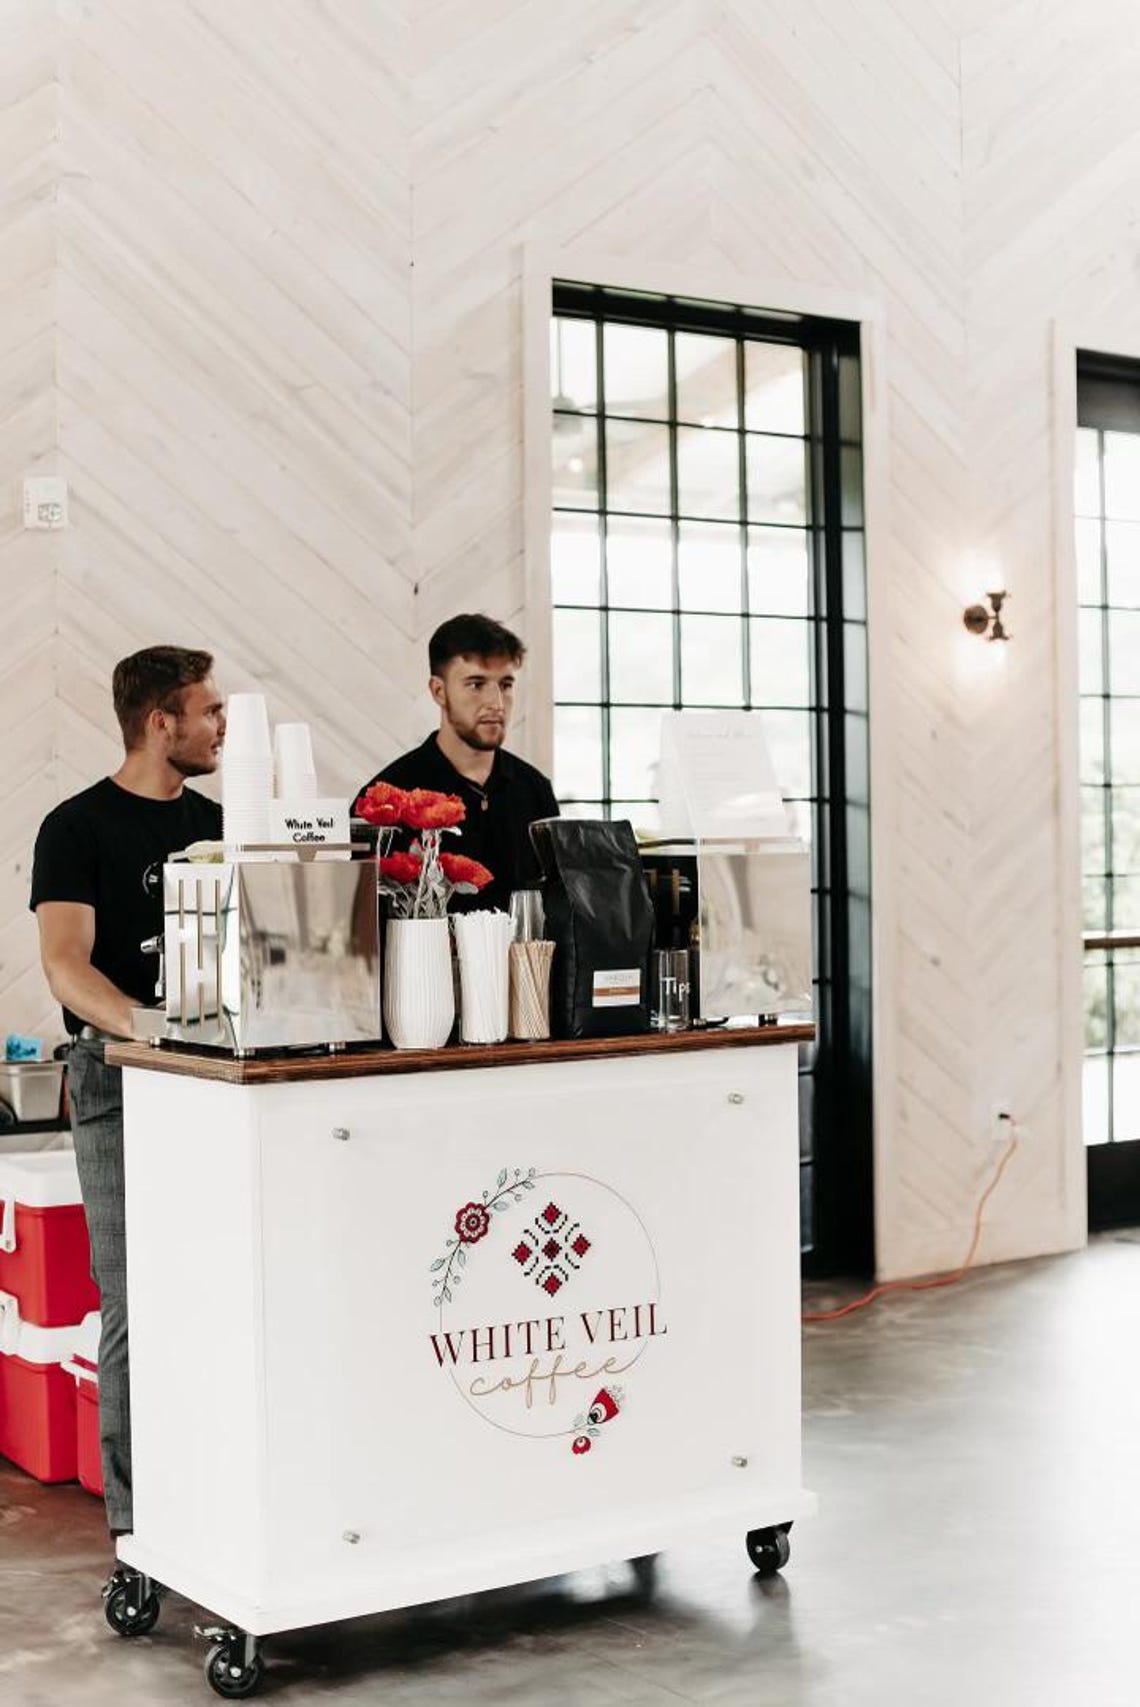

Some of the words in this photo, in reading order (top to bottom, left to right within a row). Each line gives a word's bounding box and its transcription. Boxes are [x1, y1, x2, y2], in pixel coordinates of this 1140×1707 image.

[285, 818, 312, 829] White
[293, 832, 325, 842] Coffee
[430, 1316, 566, 1368] WHITE
[580, 1302, 668, 1345] VEIL
[469, 1354, 625, 1410] coffee
